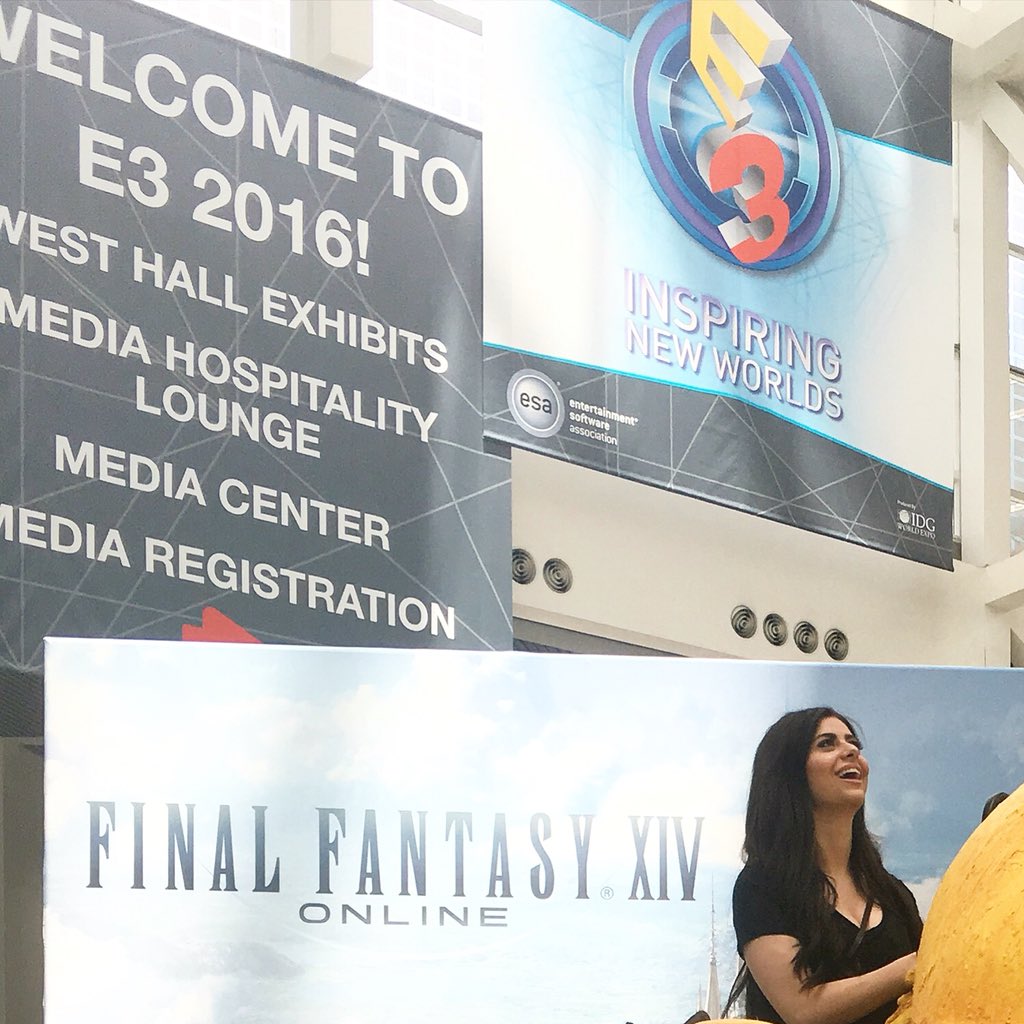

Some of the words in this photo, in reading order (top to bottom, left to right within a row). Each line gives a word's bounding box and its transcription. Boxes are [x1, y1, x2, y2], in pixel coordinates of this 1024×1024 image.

[79, 124, 170, 208] E3
[192, 168, 371, 277] 2016!
[378, 136, 469, 217] TO
[0, 204, 119, 273] WEST
[133, 246, 249, 315] HALL
[262, 287, 449, 374] EXHIBITS
[624, 268, 842, 383] INSPIRING
[0, 287, 151, 365] MEDIA
[166, 335, 439, 443] HOSPITALITY
[519, 392, 552, 415] esa
[625, 317, 703, 373] NEW
[712, 345, 844, 421] WORLDS
[136, 375, 321, 459] LOUNGE
[569, 399, 638, 426] entertainment
[569, 412, 610, 431] software
[569, 424, 619, 446] association
[55, 434, 206, 507] MEDIA
[219, 478, 390, 551] CENTER
[911, 512, 936, 533] IDG
[145, 537, 456, 640] REGISTRATION
[86, 801, 281, 894] FINAL
[314, 807, 597, 900] FANTASY
[627, 815, 706, 902] XIV
[299, 902, 508, 927] ONLINE
